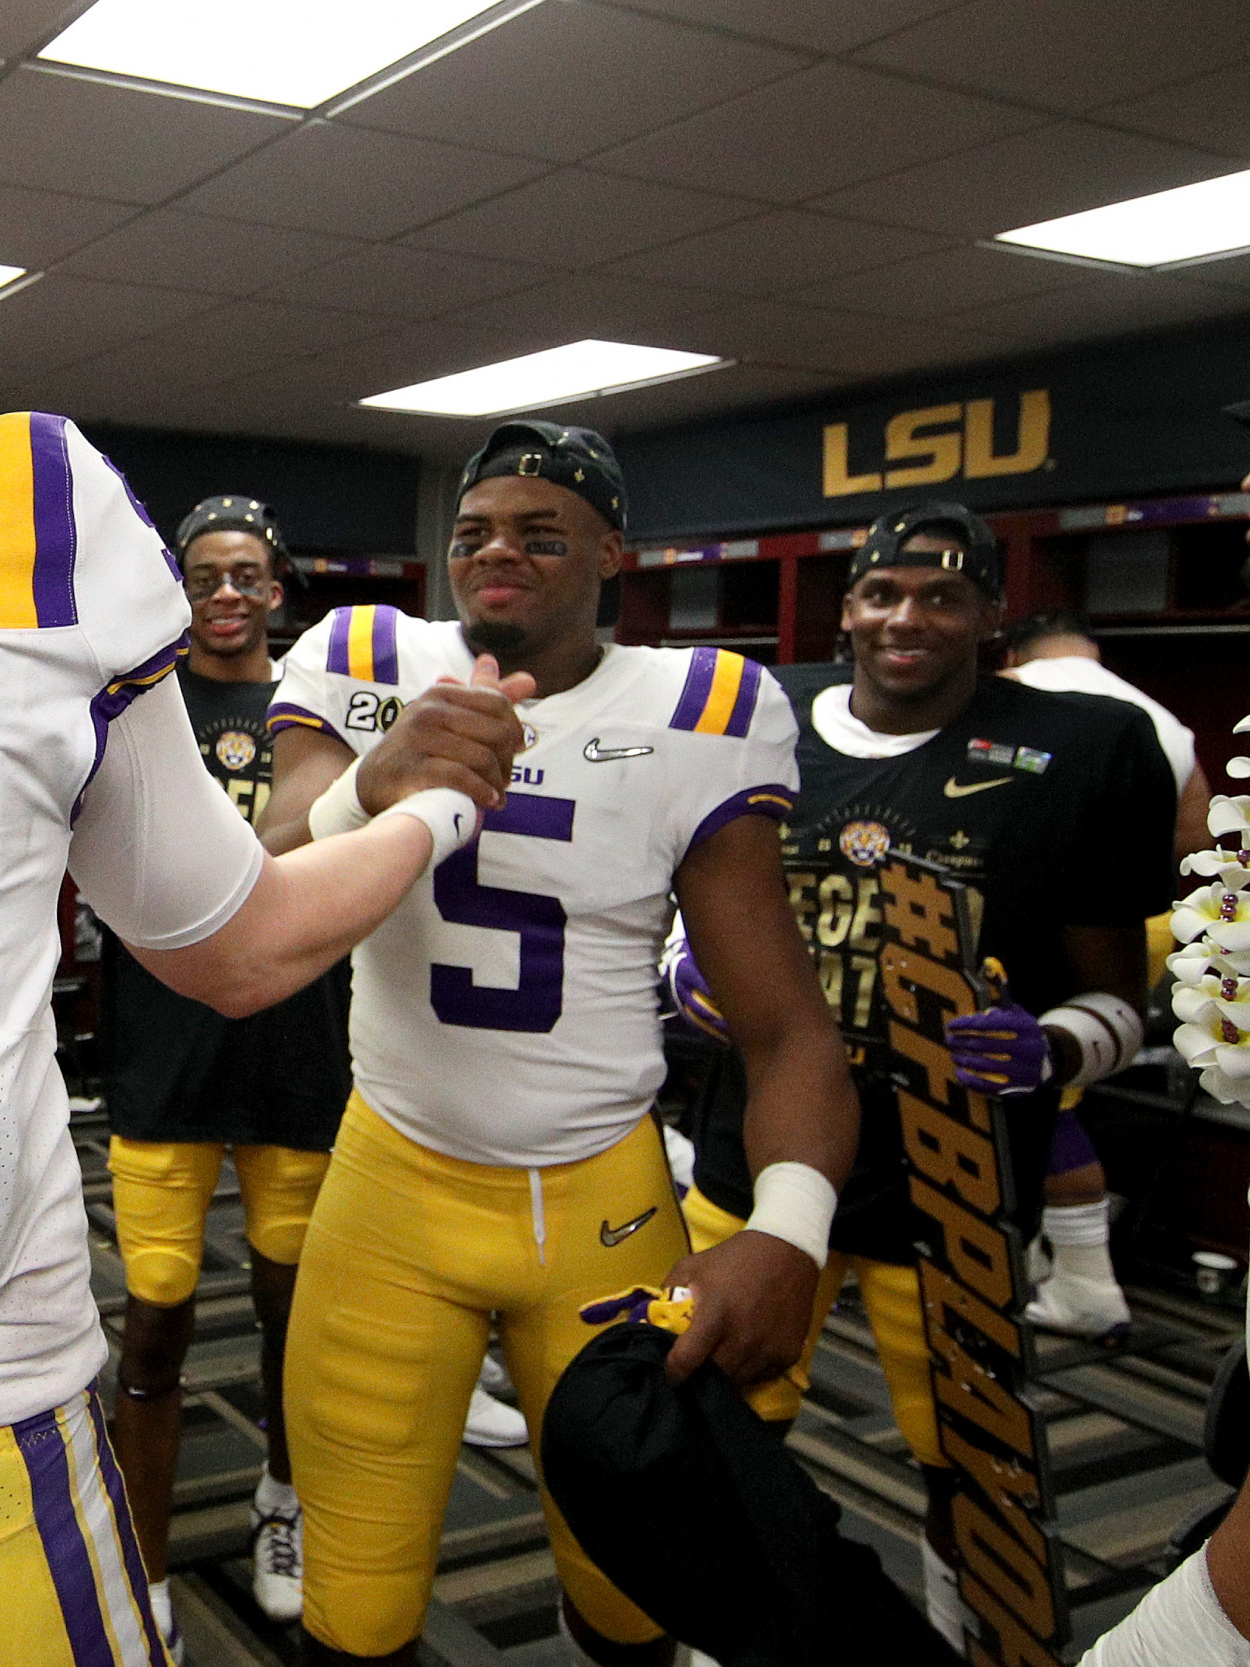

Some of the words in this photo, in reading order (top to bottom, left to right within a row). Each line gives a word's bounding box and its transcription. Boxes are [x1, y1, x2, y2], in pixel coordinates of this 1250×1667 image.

[822, 390, 1051, 498] LSU
[510, 765, 545, 786] SU
[430, 791, 576, 1034] 5
